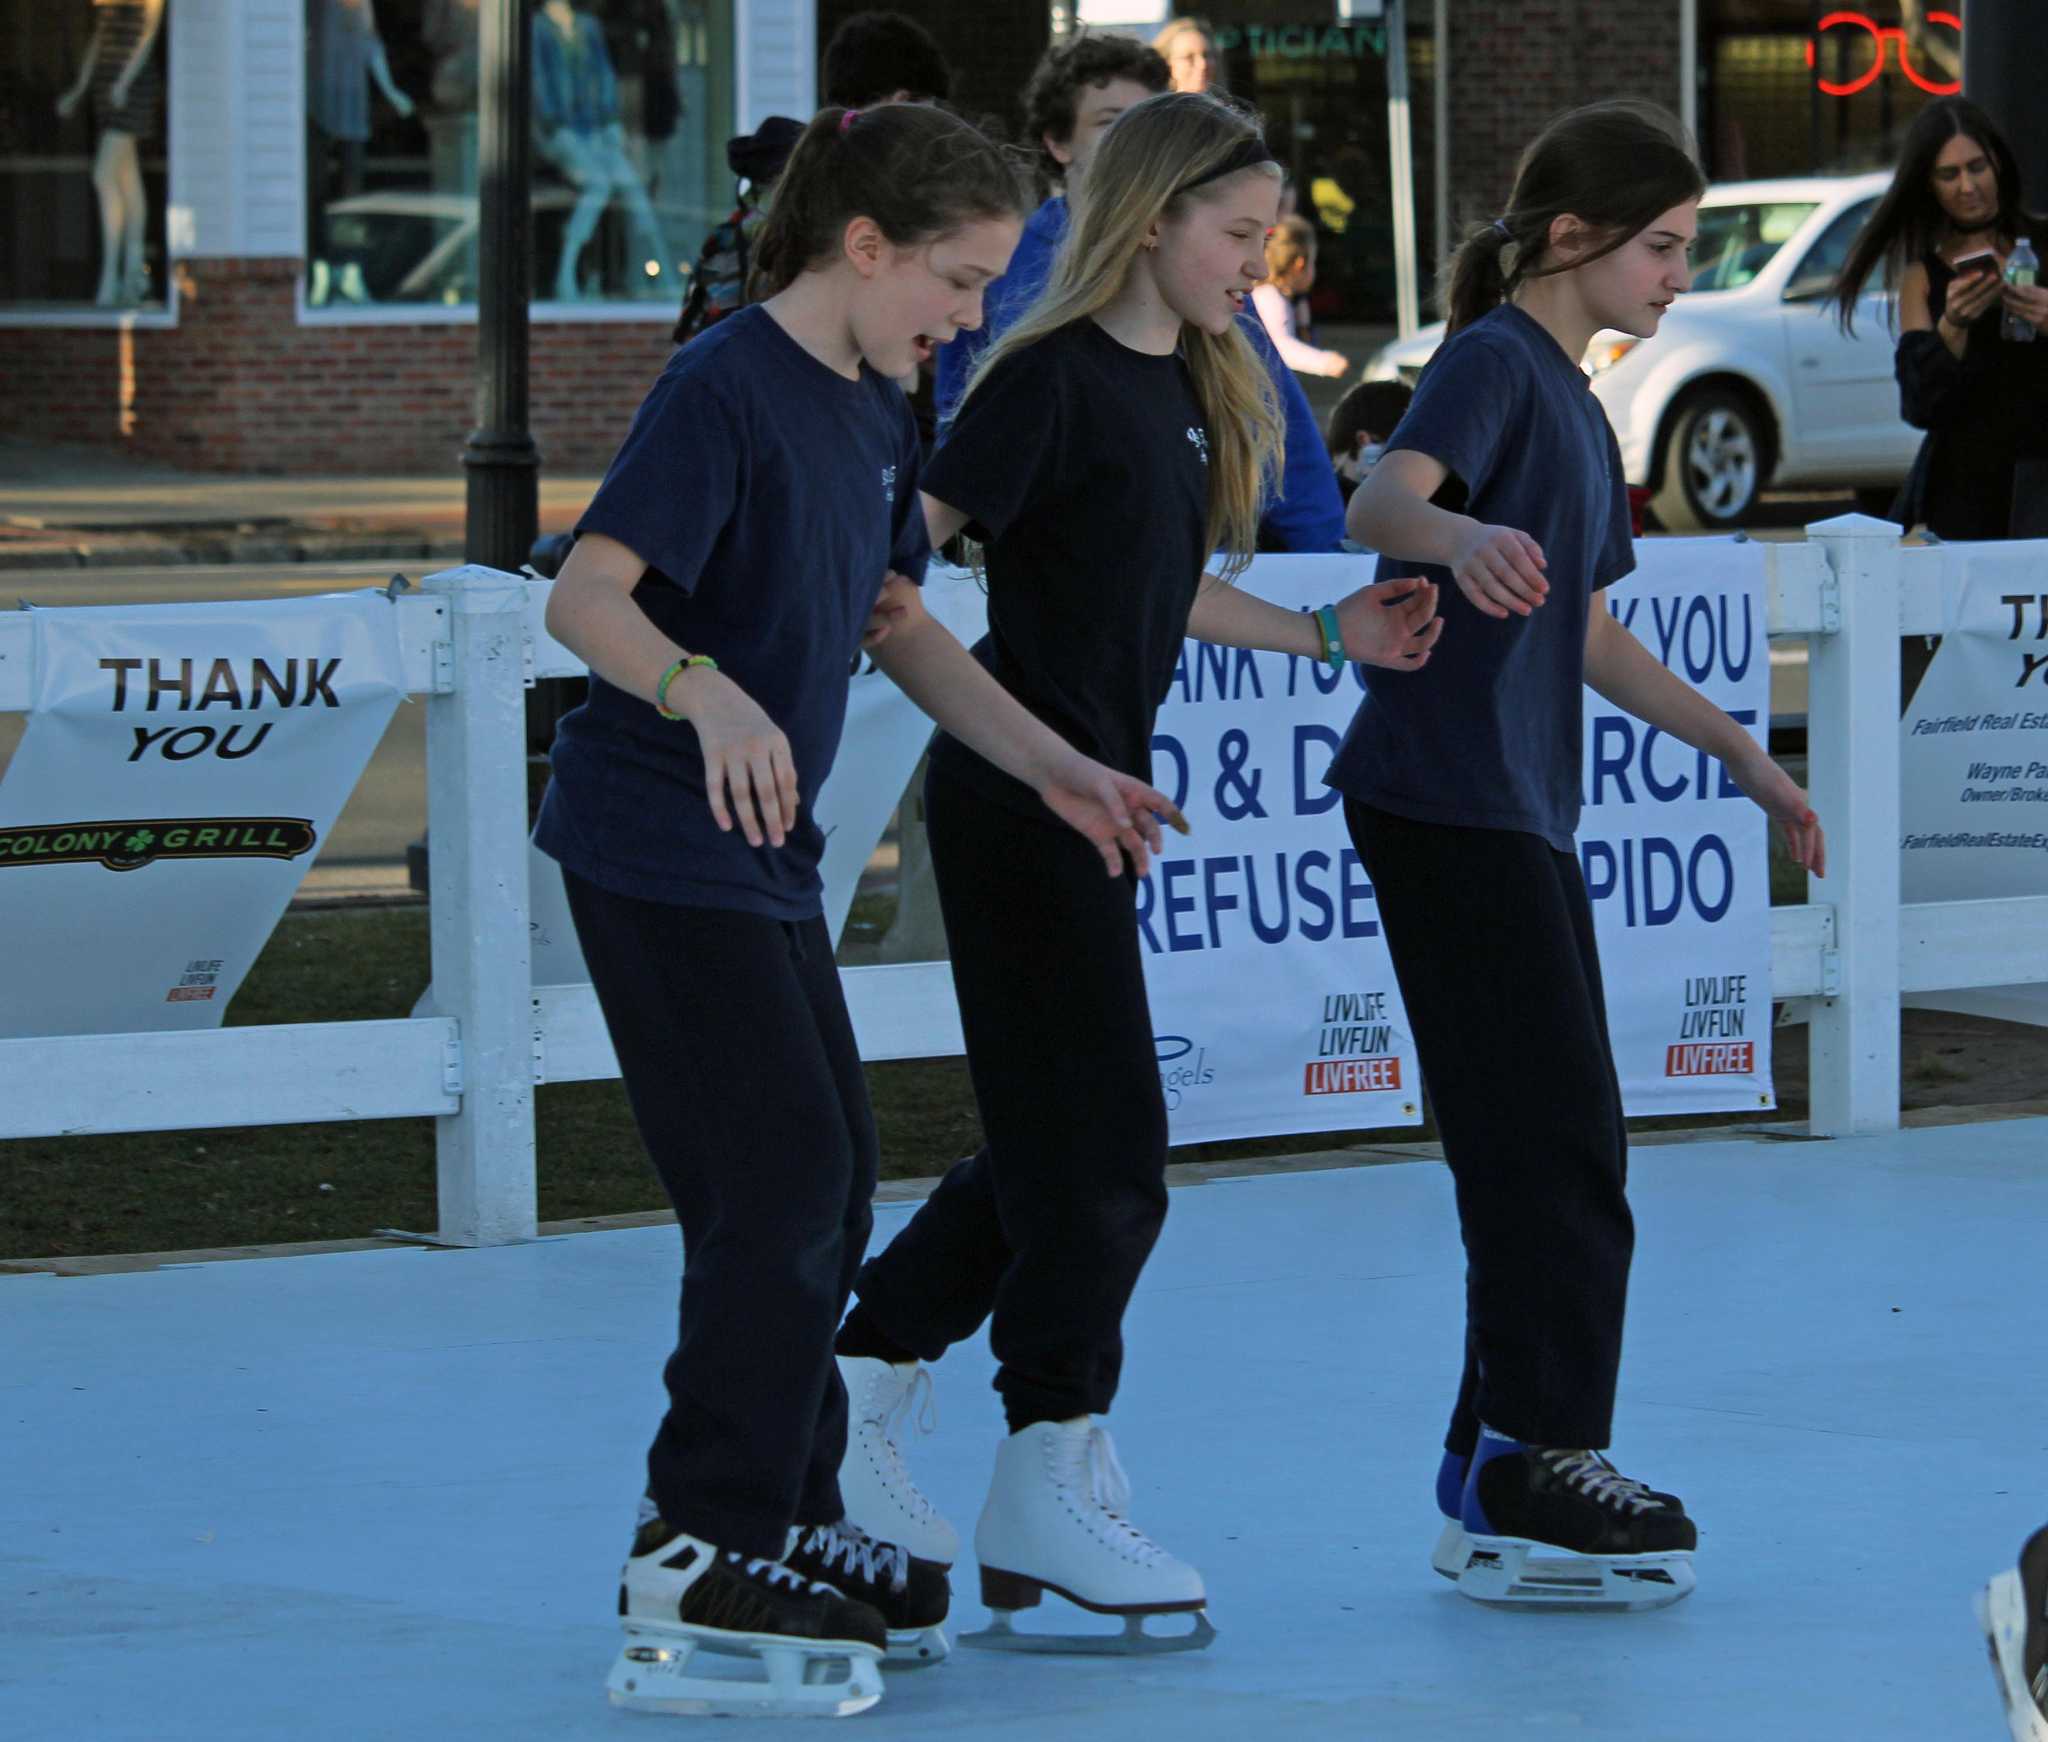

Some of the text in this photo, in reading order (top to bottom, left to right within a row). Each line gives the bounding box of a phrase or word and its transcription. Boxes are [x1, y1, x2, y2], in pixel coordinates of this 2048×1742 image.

[1652, 594, 1752, 684] YOU
[98, 657, 342, 712] THANK
[1979, 713, 2019, 731] Real
[127, 722, 274, 762] YOU
[1214, 728, 1269, 822] &
[1967, 762, 2023, 783] Wayne
[163, 828, 288, 848] GRILL
[1135, 848, 1380, 954] REFUSE
[1685, 975, 1748, 1007] LIVLIFE
[1324, 992, 1387, 1023] LIVLIFE
[1680, 1009, 1744, 1039] LIVFUN
[1319, 1026, 1391, 1056] LIVFUN
[1671, 1044, 1750, 1075] LIVFREE
[1311, 1060, 1396, 1093] LIVFREE
